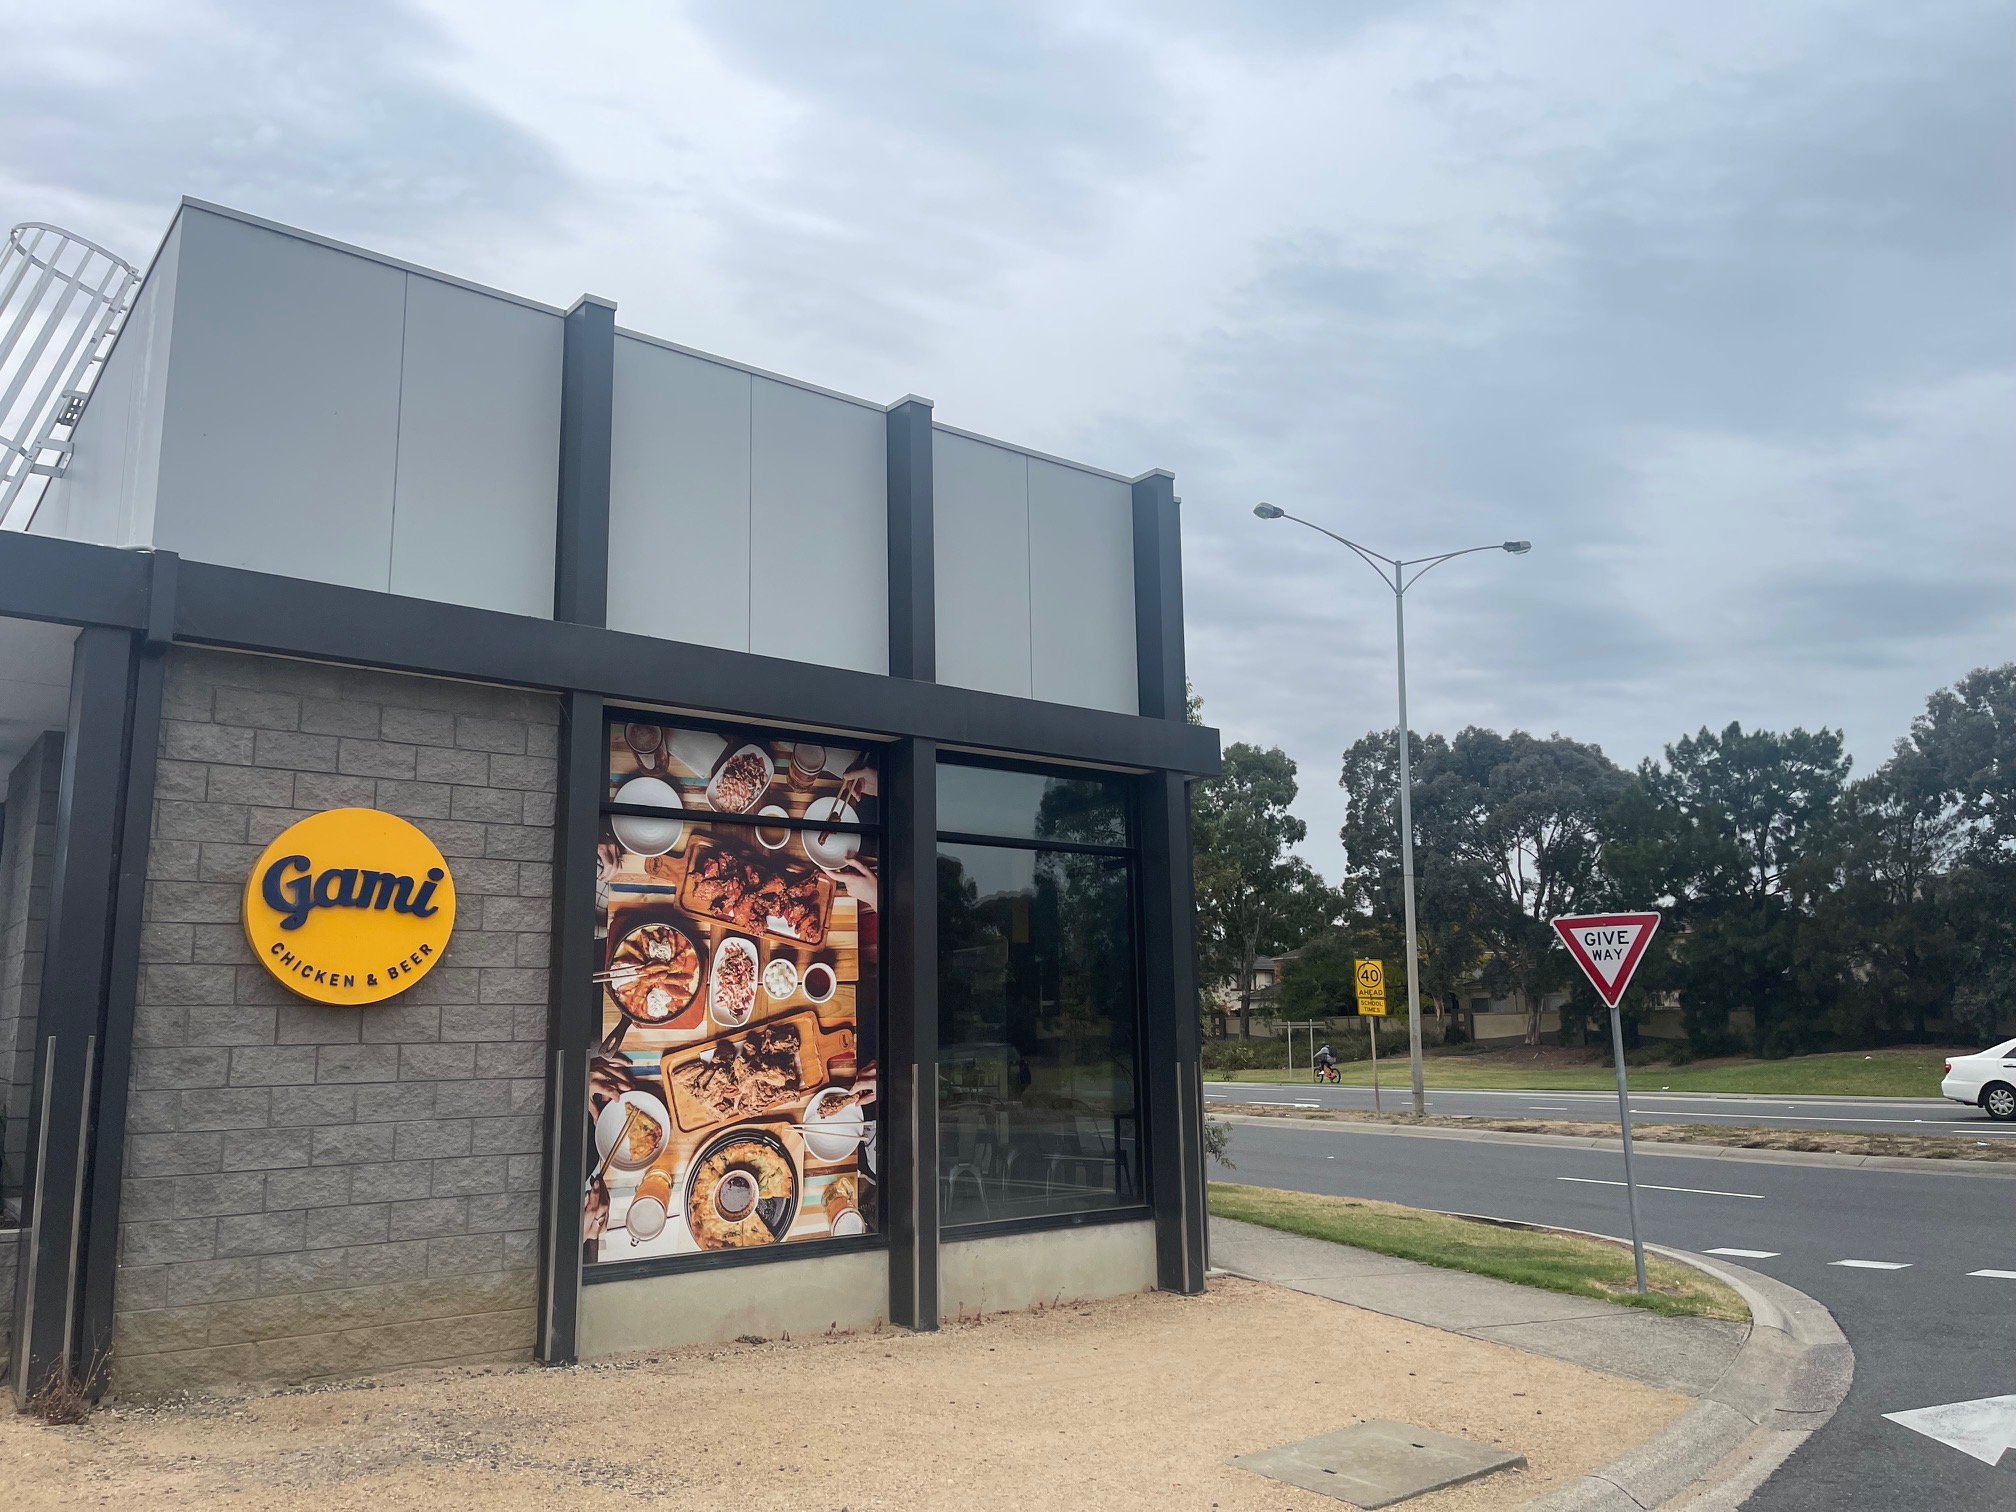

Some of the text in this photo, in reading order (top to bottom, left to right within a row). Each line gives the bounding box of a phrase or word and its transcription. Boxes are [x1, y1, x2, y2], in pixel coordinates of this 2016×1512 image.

[262, 855, 444, 930] Gami
[1584, 930, 1629, 946] GIVE
[1592, 948, 1623, 961] WAY
[270, 942, 433, 987] CHICKEN & BEER
[1360, 969, 1379, 982] 40
